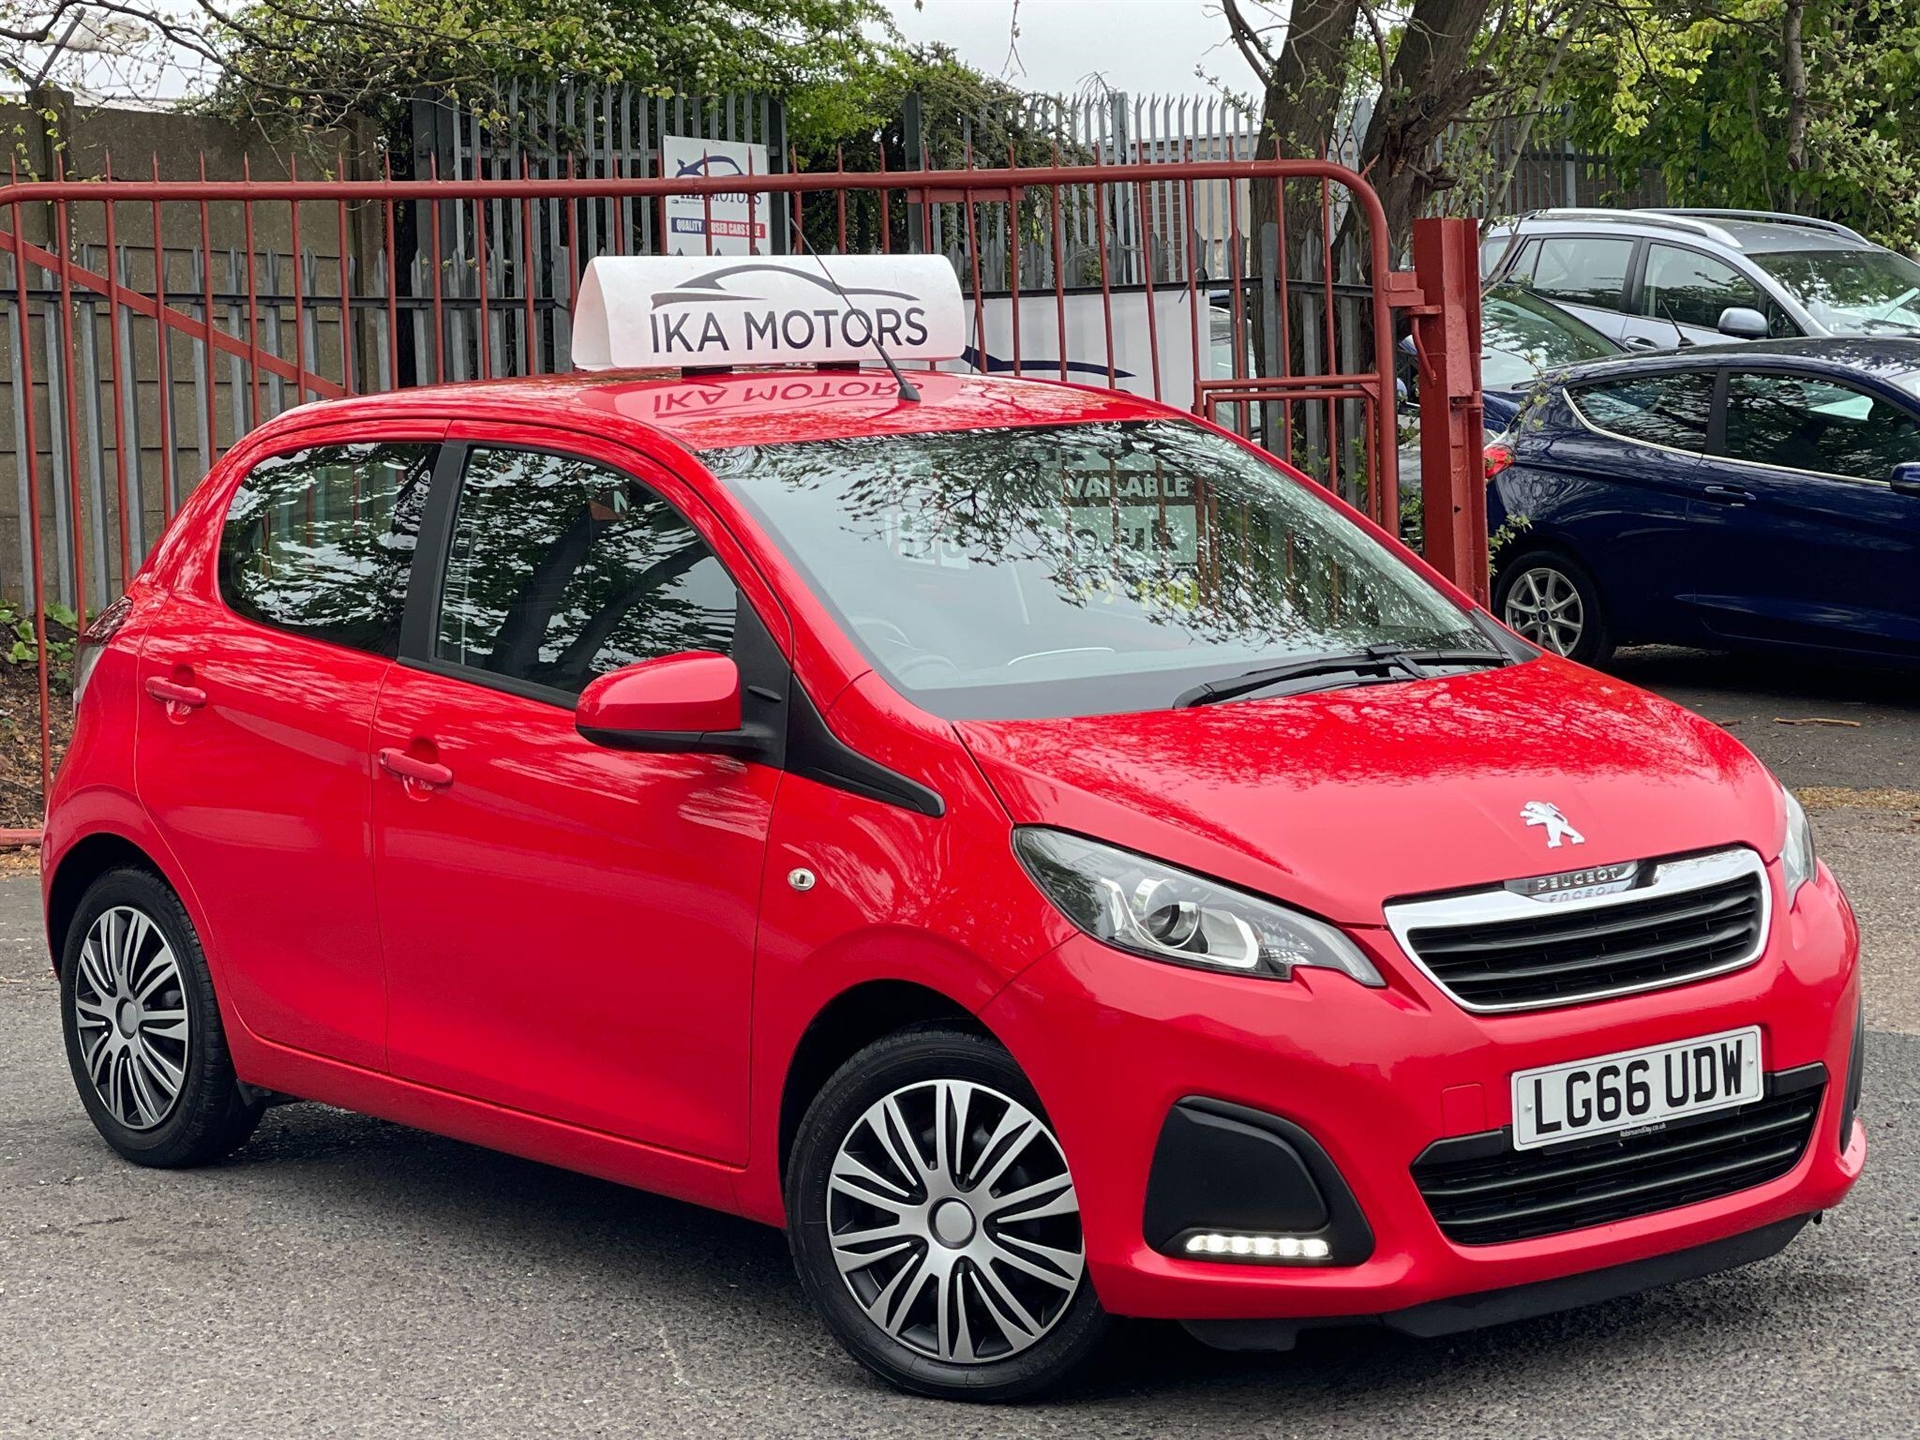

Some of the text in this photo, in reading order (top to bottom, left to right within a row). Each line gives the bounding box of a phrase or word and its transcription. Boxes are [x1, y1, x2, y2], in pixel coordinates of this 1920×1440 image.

[676, 218, 761, 236] QUALITY USED CARS SLE
[650, 307, 928, 353] IKA MOTORS
[1537, 867, 1618, 891] PEUGEOT
[1534, 1039, 1743, 1135] LG66 UDW
